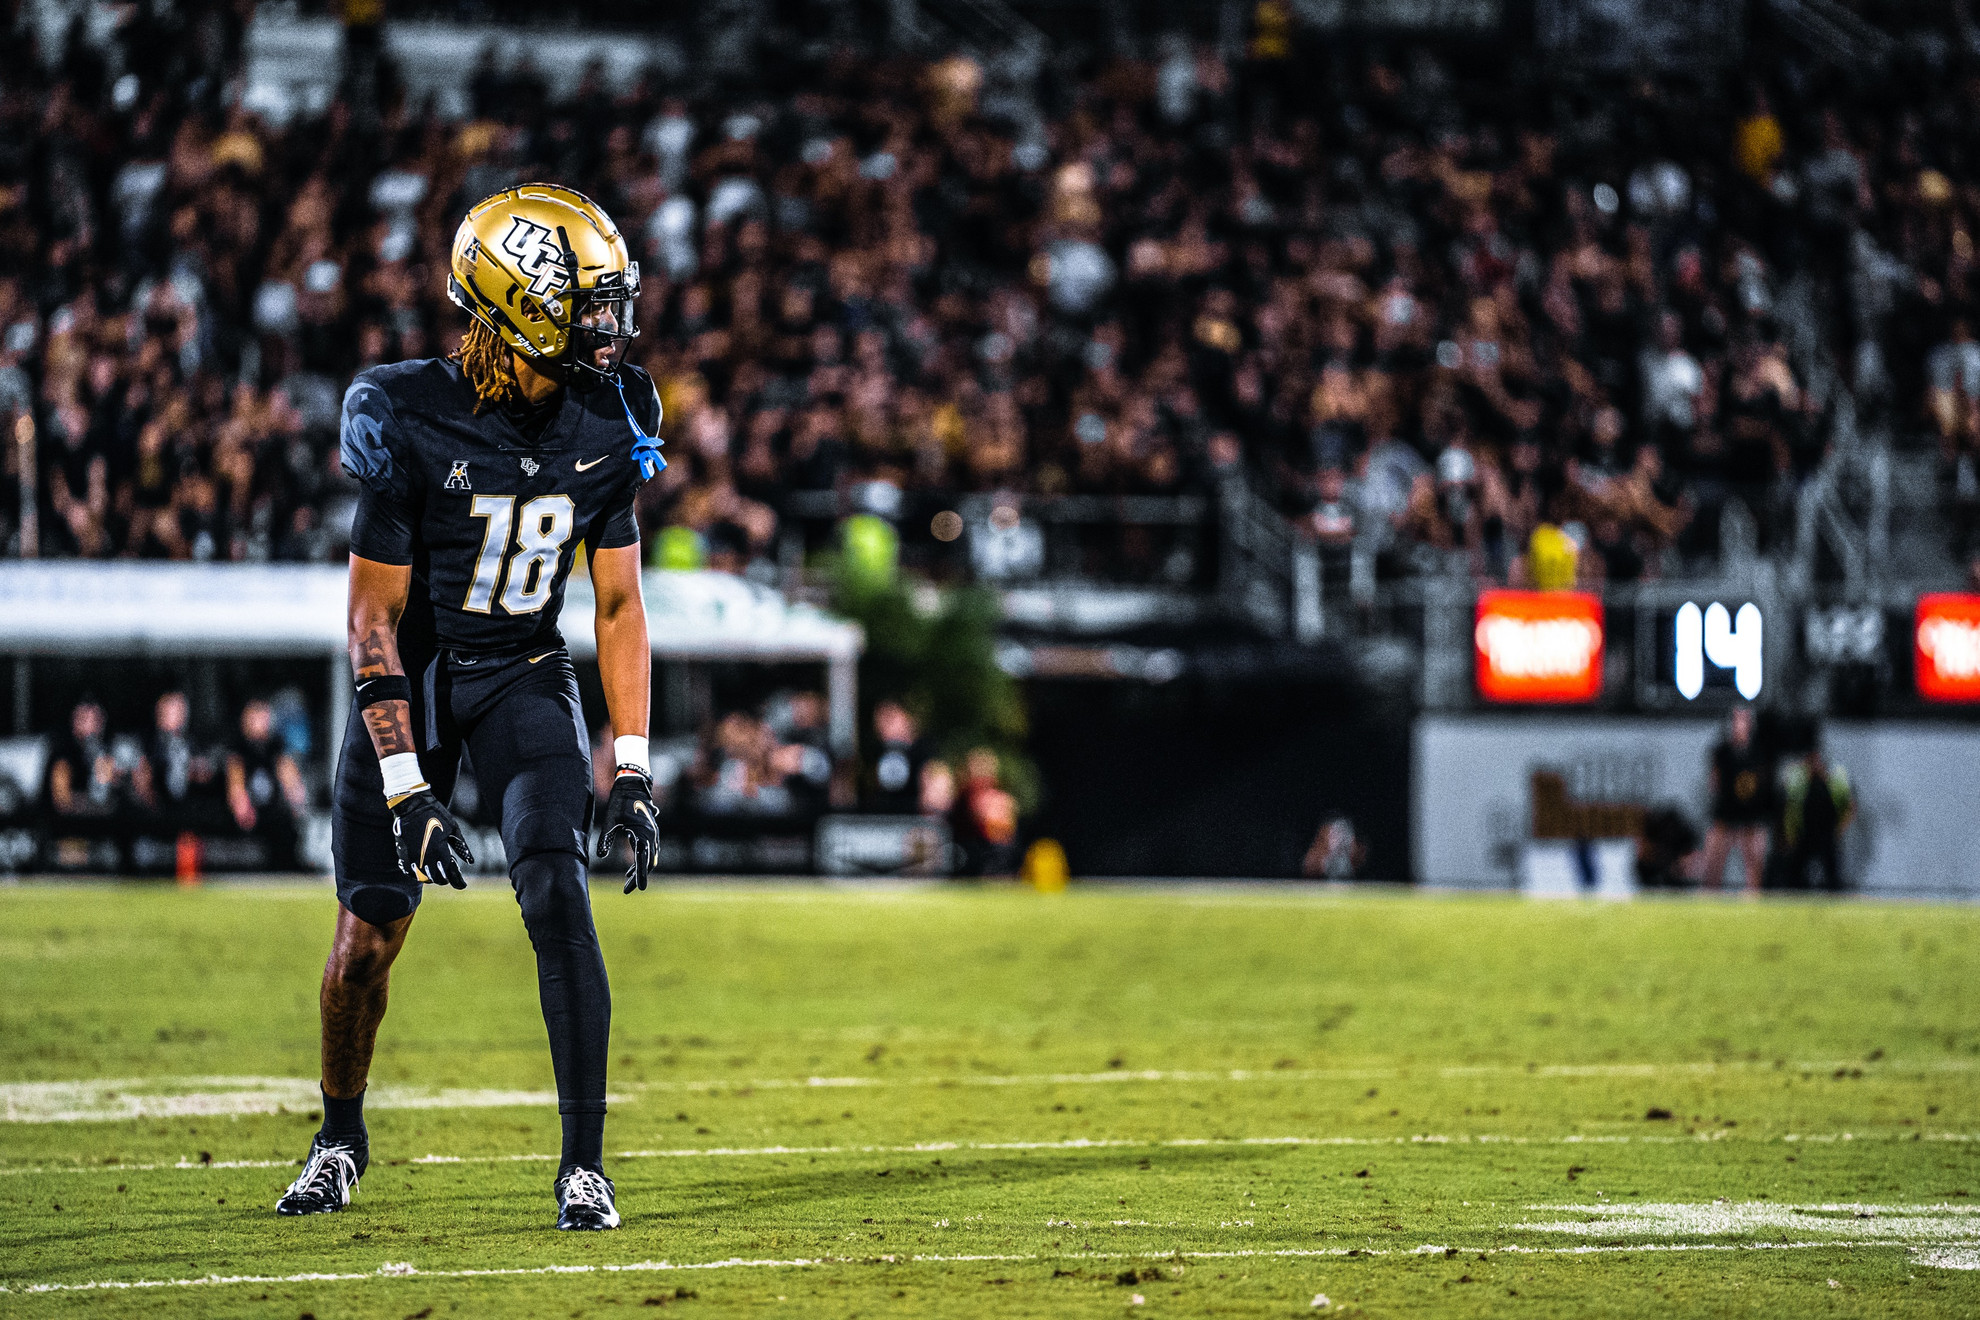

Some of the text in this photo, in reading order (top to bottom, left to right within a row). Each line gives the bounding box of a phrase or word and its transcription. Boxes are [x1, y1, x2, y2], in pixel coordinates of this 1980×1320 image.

[502, 213, 571, 298] UCF
[514, 333, 541, 358] schutt
[520, 457, 540, 477] UCF
[462, 494, 576, 615] 18
[1675, 601, 1763, 700] 14
